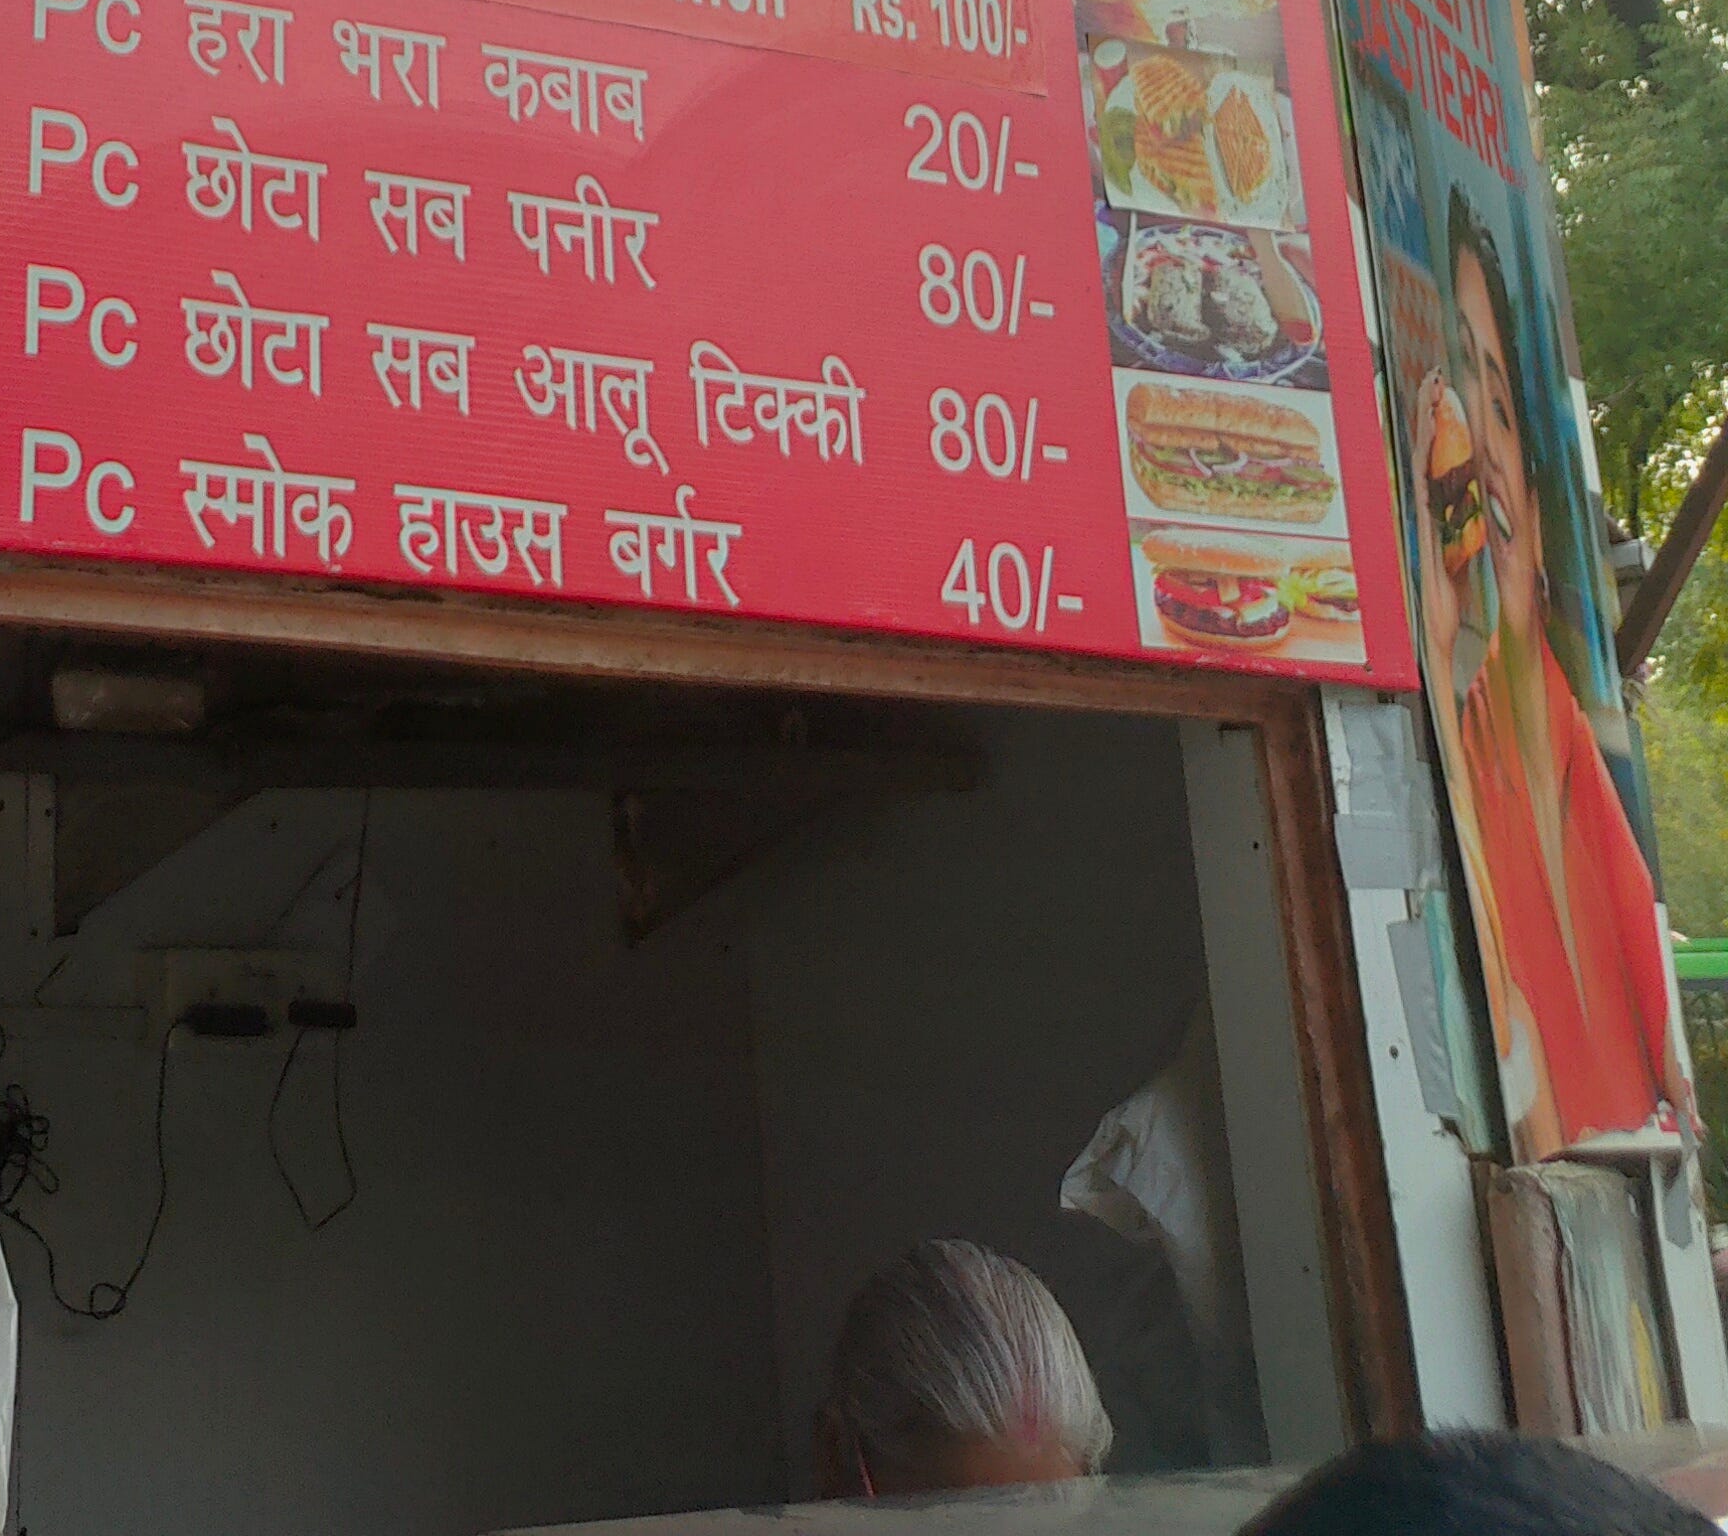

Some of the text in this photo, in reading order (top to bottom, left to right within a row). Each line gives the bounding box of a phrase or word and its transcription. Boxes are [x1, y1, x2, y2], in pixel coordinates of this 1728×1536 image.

[332, 20, 445, 108] भरा
[481, 43, 648, 139] कबाब
[28, 107, 137, 207] Pc
[182, 116, 327, 241] छोटा
[364, 170, 469, 261] सब
[507, 174, 659, 289] पनीर
[904, 104, 1039, 194] 20/-
[919, 244, 1054, 335] 80/-
[25, 265, 136, 368] Pc
[181, 270, 329, 396] छोटा
[367, 323, 475, 414] सब
[514, 345, 669, 472] आलू
[689, 340, 865, 463] टिक्की
[929, 388, 1067, 480] 80/-
[20, 429, 134, 534] Pc
[393, 483, 567, 586] हाउस
[604, 484, 741, 606] बर्गर
[941, 539, 1082, 631] 40/-
